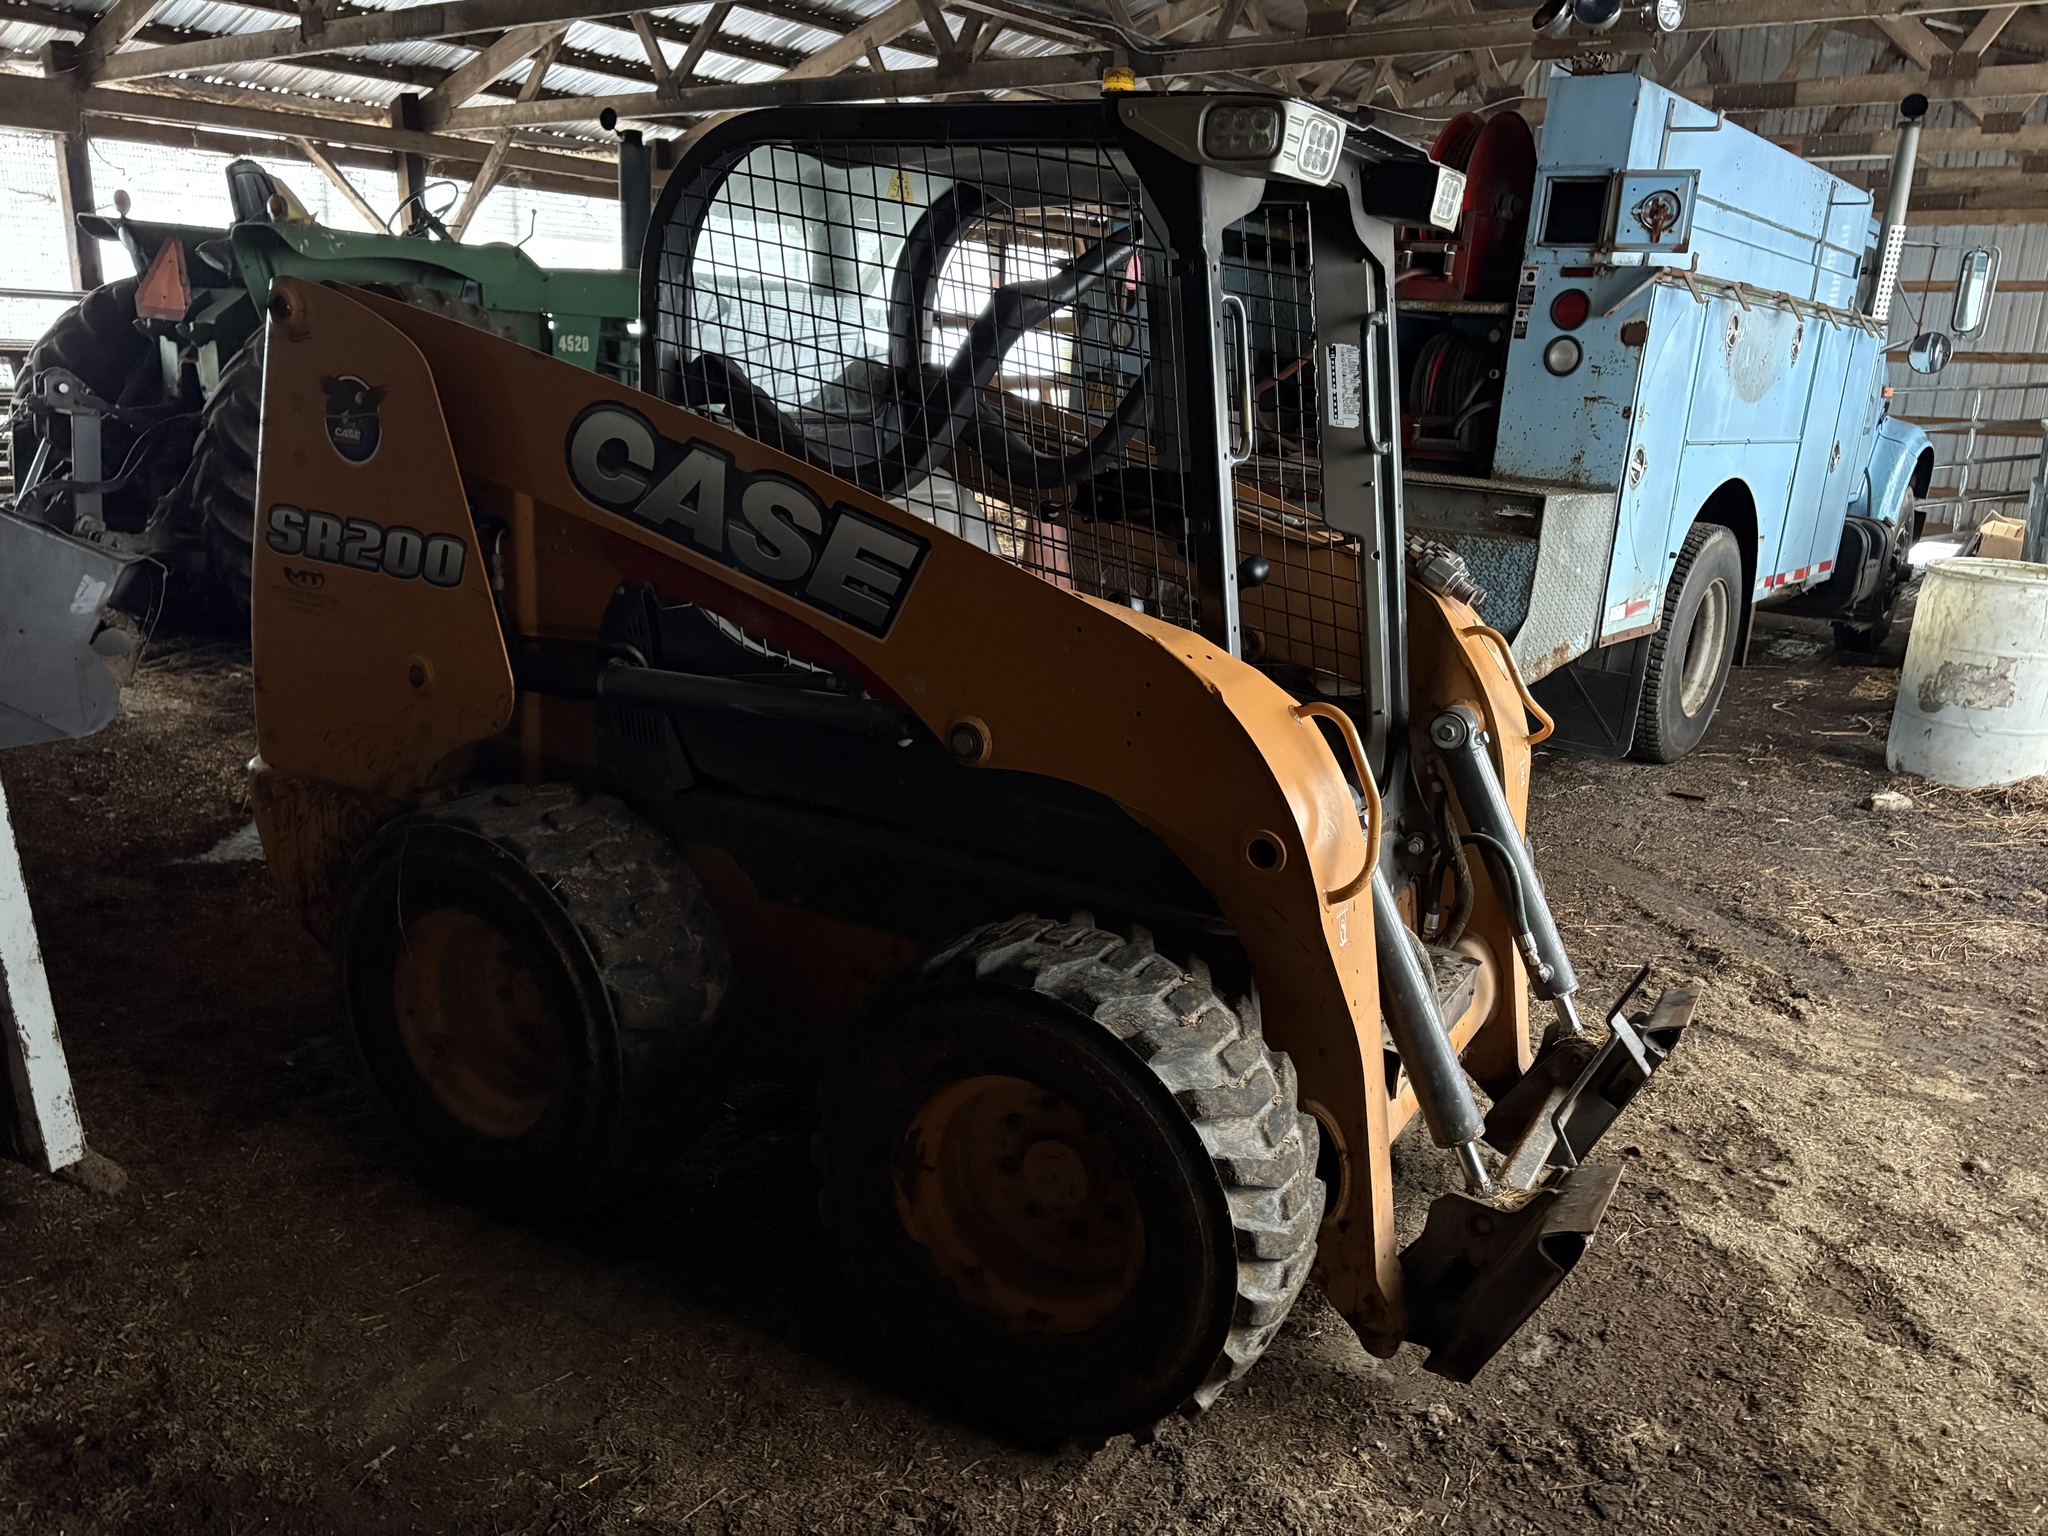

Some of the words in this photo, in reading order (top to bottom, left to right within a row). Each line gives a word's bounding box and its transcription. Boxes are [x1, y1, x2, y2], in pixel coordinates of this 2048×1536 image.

[558, 335, 590, 353] 4520
[334, 427, 362, 440] CASE
[569, 408, 922, 630] CASE
[266, 504, 467, 588] SR200
